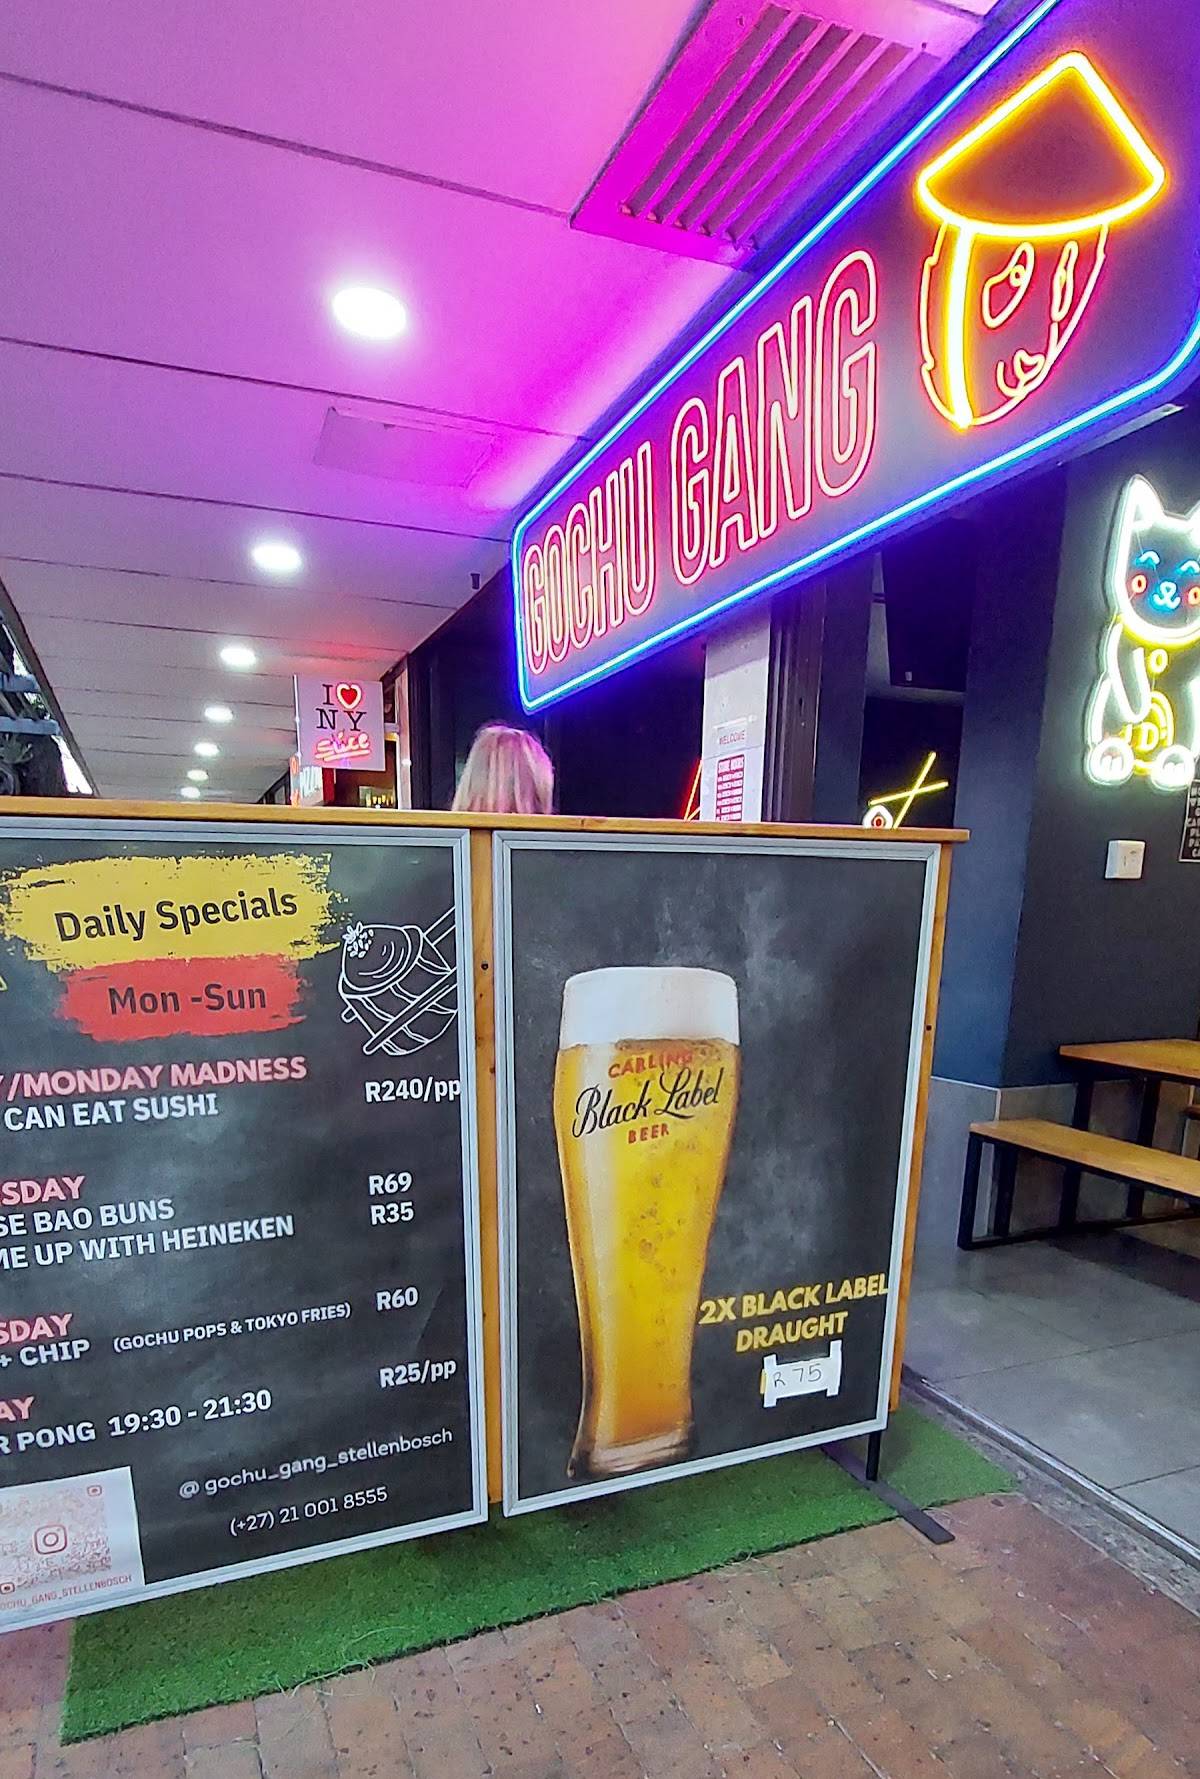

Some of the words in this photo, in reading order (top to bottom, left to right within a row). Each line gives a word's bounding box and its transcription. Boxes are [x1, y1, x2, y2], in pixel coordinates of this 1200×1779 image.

[523, 440, 656, 675] GOCHU
[670, 250, 877, 585] GANG
[54, 904, 146, 942] Daily
[156, 887, 298, 933] Specials
[108, 986, 180, 1015] Mon
[170, 1056, 307, 1087] MADNESS
[365, 1078, 461, 1103] R240/pp
[4, 1104, 66, 1131] CAN
[72, 1099, 126, 1125] EAT
[133, 1093, 219, 1120] SUSHI
[572, 1080, 651, 1137] Black
[654, 1067, 724, 1119] Label
[628, 1123, 670, 1143] BEER
[369, 1171, 413, 1196] R69
[33, 1207, 93, 1233] BAO
[99, 1198, 175, 1227] BUNS
[370, 1202, 414, 1226] R35
[35, 1241, 74, 1266] UP
[79, 1233, 156, 1261] WITH
[161, 1215, 294, 1252] HEINEKEN
[376, 1286, 419, 1311] R60
[699, 1297, 736, 1324] 2X
[742, 1285, 822, 1318] BLACK
[825, 1273, 889, 1304] LABEL
[19, 1339, 90, 1366] CHIP
[183, 1323, 227, 1342] POPS
[245, 1311, 299, 1332] TOKYO
[302, 1302, 351, 1324] FRIES)
[736, 1311, 848, 1352] DRAUGHT
[380, 1359, 457, 1389] R25/pp
[17, 1421, 96, 1452] PONG
[108, 1405, 181, 1437] 19:30
[203, 1389, 271, 1420] 21:30
[230, 1513, 275, 1537] (+27)
[280, 1507, 299, 1524] 21
[343, 1486, 388, 1511] 8555
